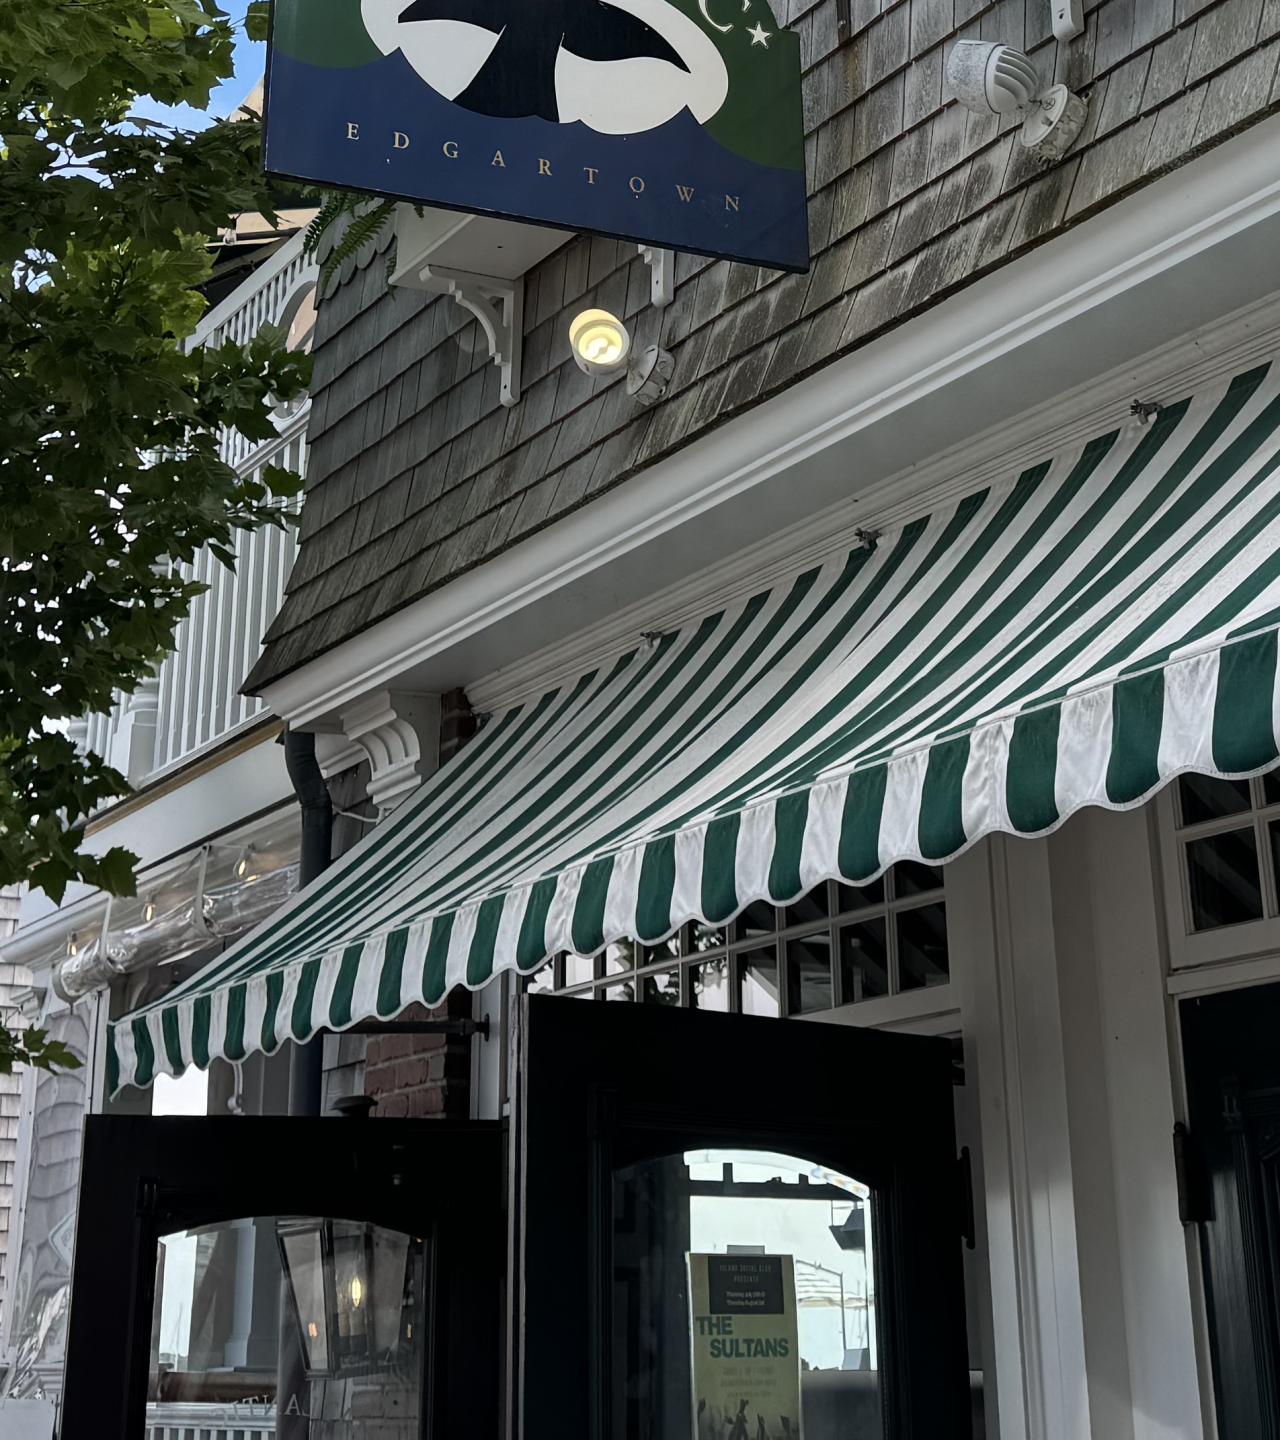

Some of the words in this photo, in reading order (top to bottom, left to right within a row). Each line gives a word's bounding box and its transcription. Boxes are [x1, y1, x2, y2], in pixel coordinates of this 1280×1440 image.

[346, 122, 740, 212] EDGARTOWN
[695, 1316, 733, 1336] THE
[710, 1338, 789, 1359] SULTANS
